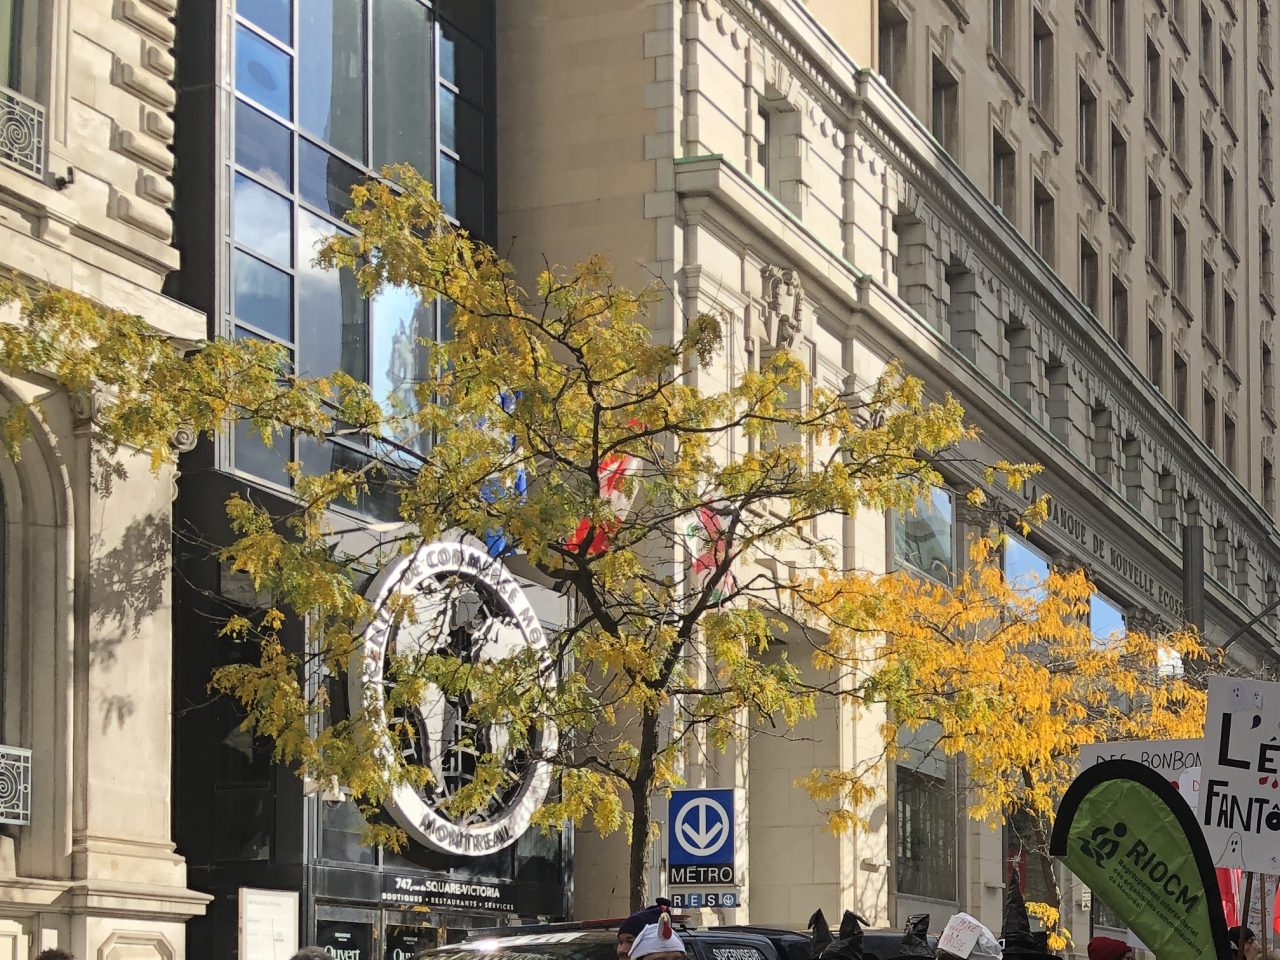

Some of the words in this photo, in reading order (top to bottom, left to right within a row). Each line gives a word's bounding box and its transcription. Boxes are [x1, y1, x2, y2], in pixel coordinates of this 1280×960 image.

[1051, 502, 1087, 545] ANQUE
[1092, 534, 1105, 560] DE
[1110, 547, 1154, 597] NOUVELLE
[1158, 586, 1184, 619] ECOSS
[426, 880, 500, 898] SQUARE-VICTORIA
[1118, 859, 1161, 901] Regroupement
[1123, 876, 1156, 912] organismes
[1126, 839, 1200, 913] RIOCM
[382, 892, 423, 903] BOUTIQUES
[431, 897, 477, 908] RESTAURANTS
[484, 902, 514, 911] SERVICES
[713, 949, 761, 960] SUPERVISEUR
